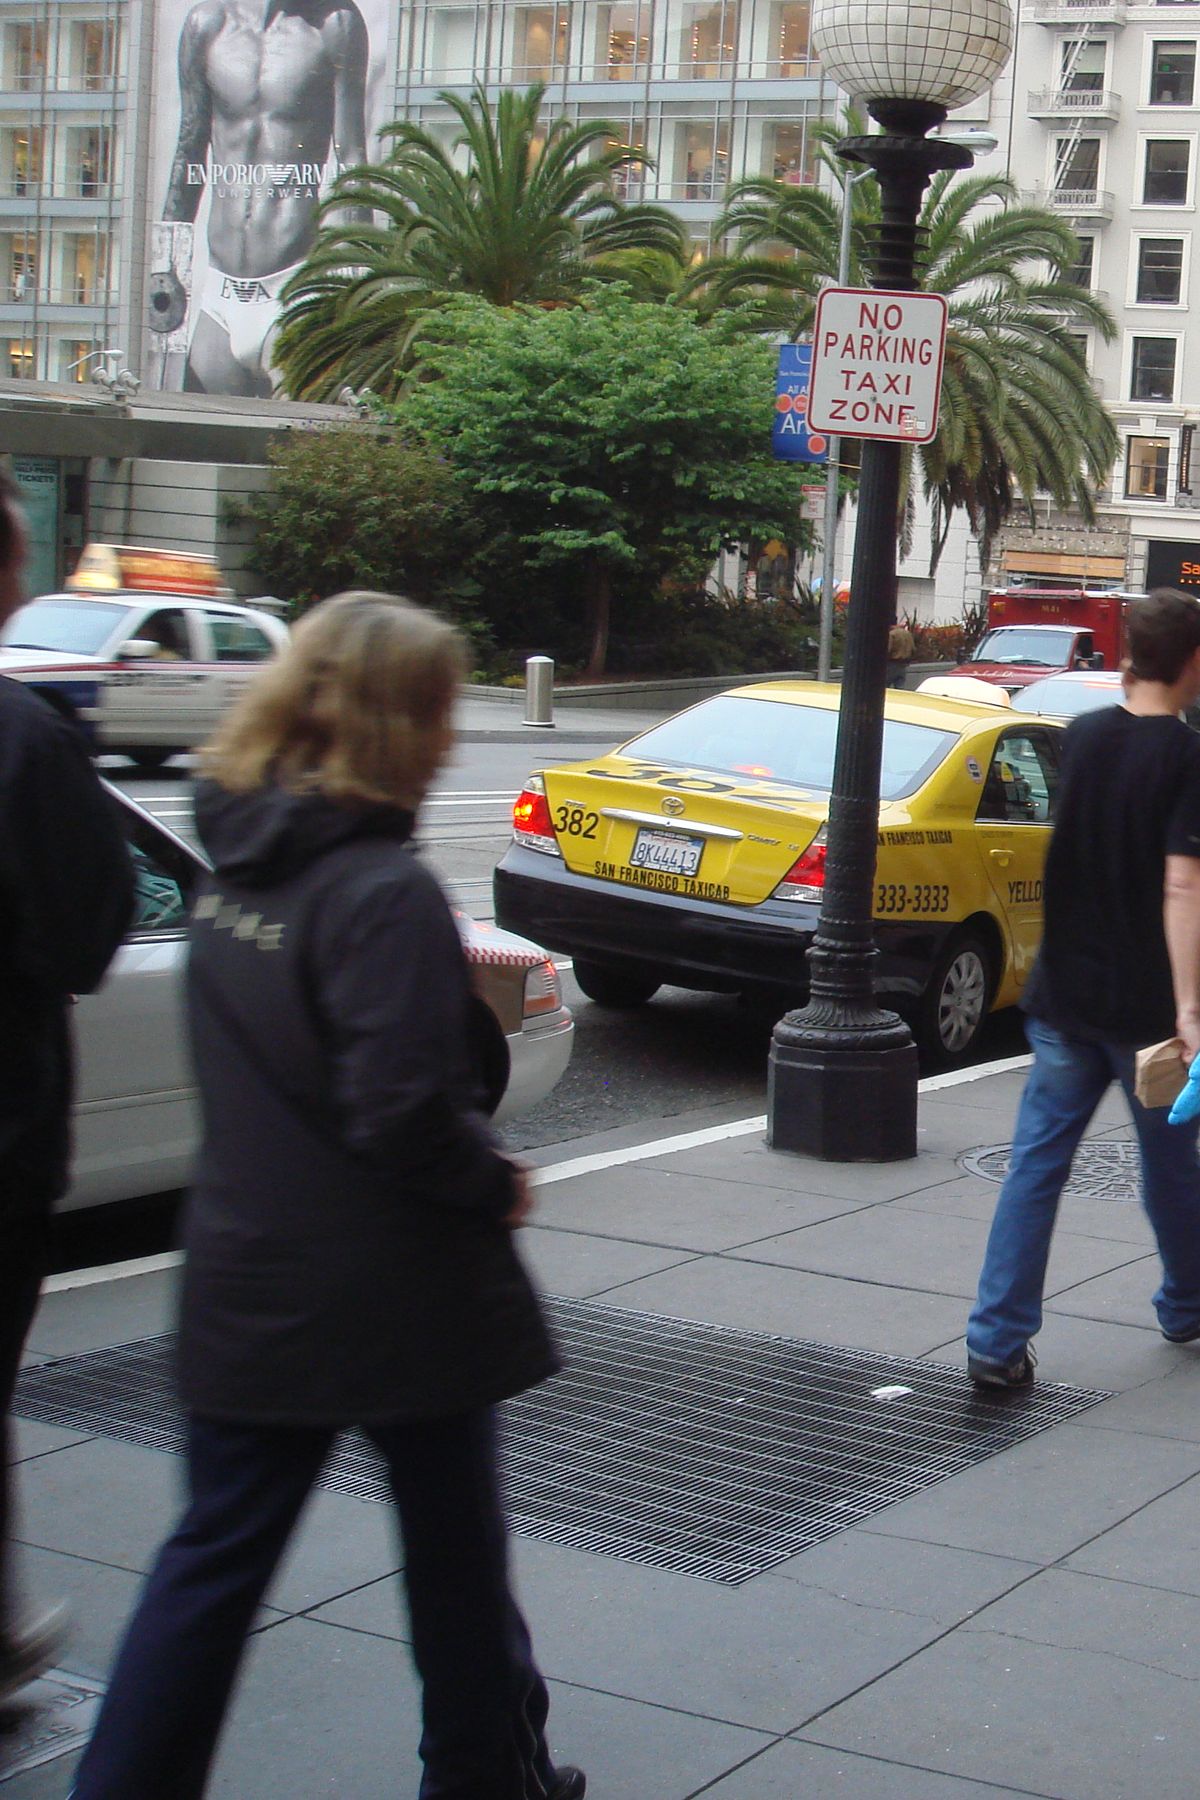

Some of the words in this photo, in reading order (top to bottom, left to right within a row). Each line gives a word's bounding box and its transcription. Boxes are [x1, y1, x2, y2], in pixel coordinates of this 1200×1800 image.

[217, 188, 315, 199] UNDERWEA
[859, 303, 903, 331] NO
[824, 332, 933, 366] PARKING
[840, 370, 912, 396] TAXI
[829, 399, 915, 426] ZONE
[553, 805, 600, 840] 382
[887, 831, 925, 847] FRANCISCO
[636, 842, 698, 870] 8K44413
[594, 860, 615, 878] SAN
[619, 865, 679, 892] FRANCISCO
[683, 878, 730, 900] TAXICAB
[1007, 880, 1044, 904] YELLO
[876, 884, 950, 913] 333-3333
